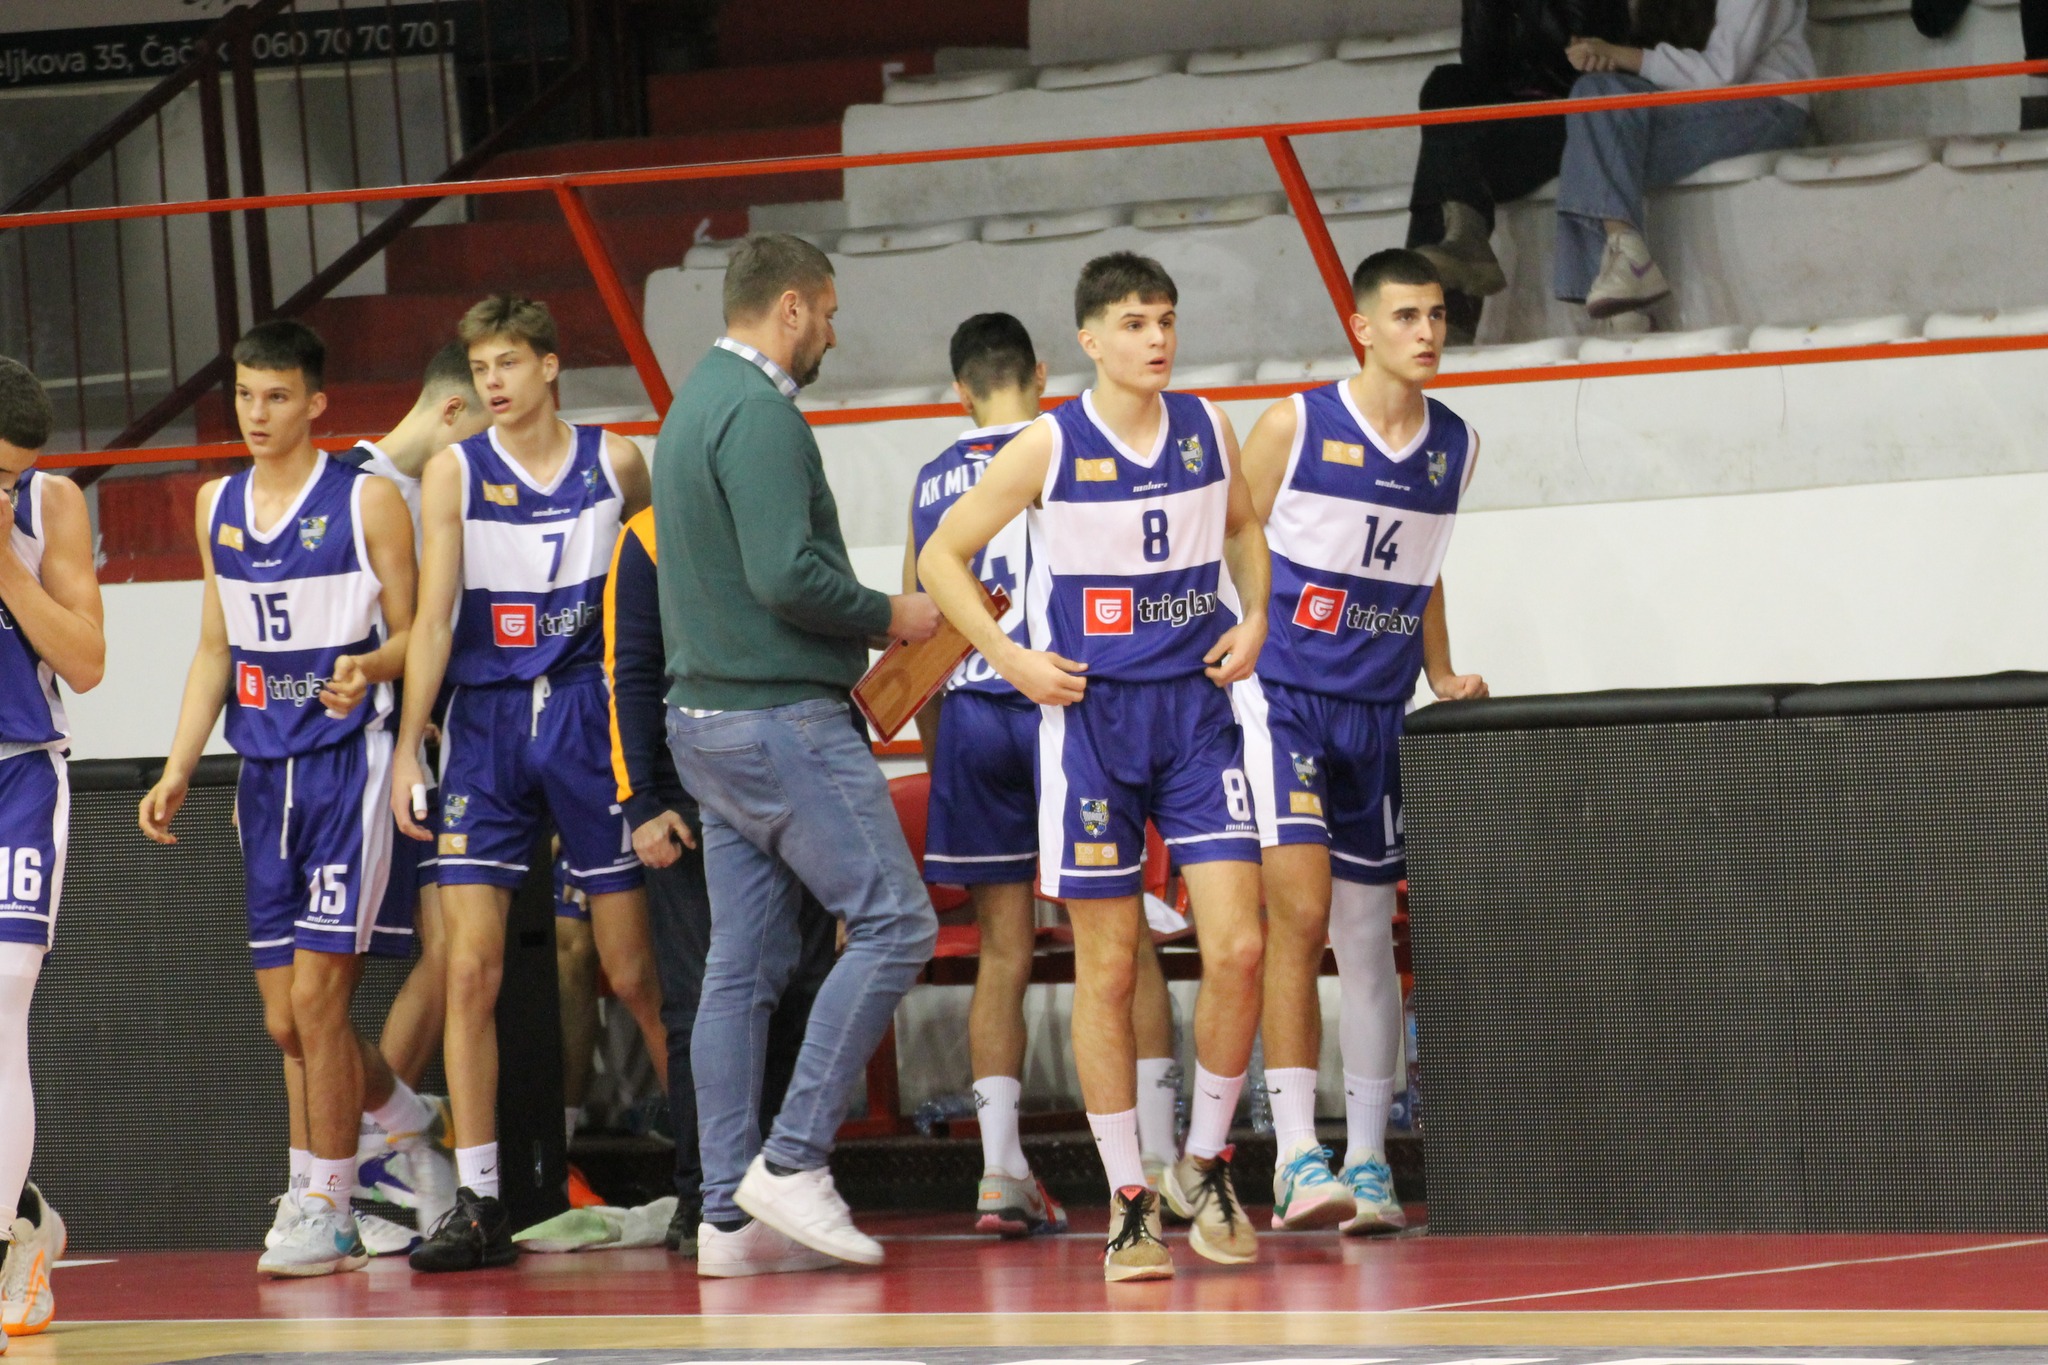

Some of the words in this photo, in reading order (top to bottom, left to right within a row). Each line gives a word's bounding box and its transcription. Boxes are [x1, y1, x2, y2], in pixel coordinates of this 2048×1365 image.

[93, 43, 134, 73] 35,
[252, 31, 308, 60] 060
[314, 28, 351, 56] 70
[542, 532, 565, 583] 7
[1141, 508, 1170, 563] 8
[1361, 515, 1403, 571] 14
[250, 591, 293, 642] 15
[1137, 589, 1217, 628] triglav
[267, 672, 333, 708] trigla
[1222, 768, 1251, 822] 8
[0, 846, 42, 902] 16
[309, 864, 348, 915] 15
